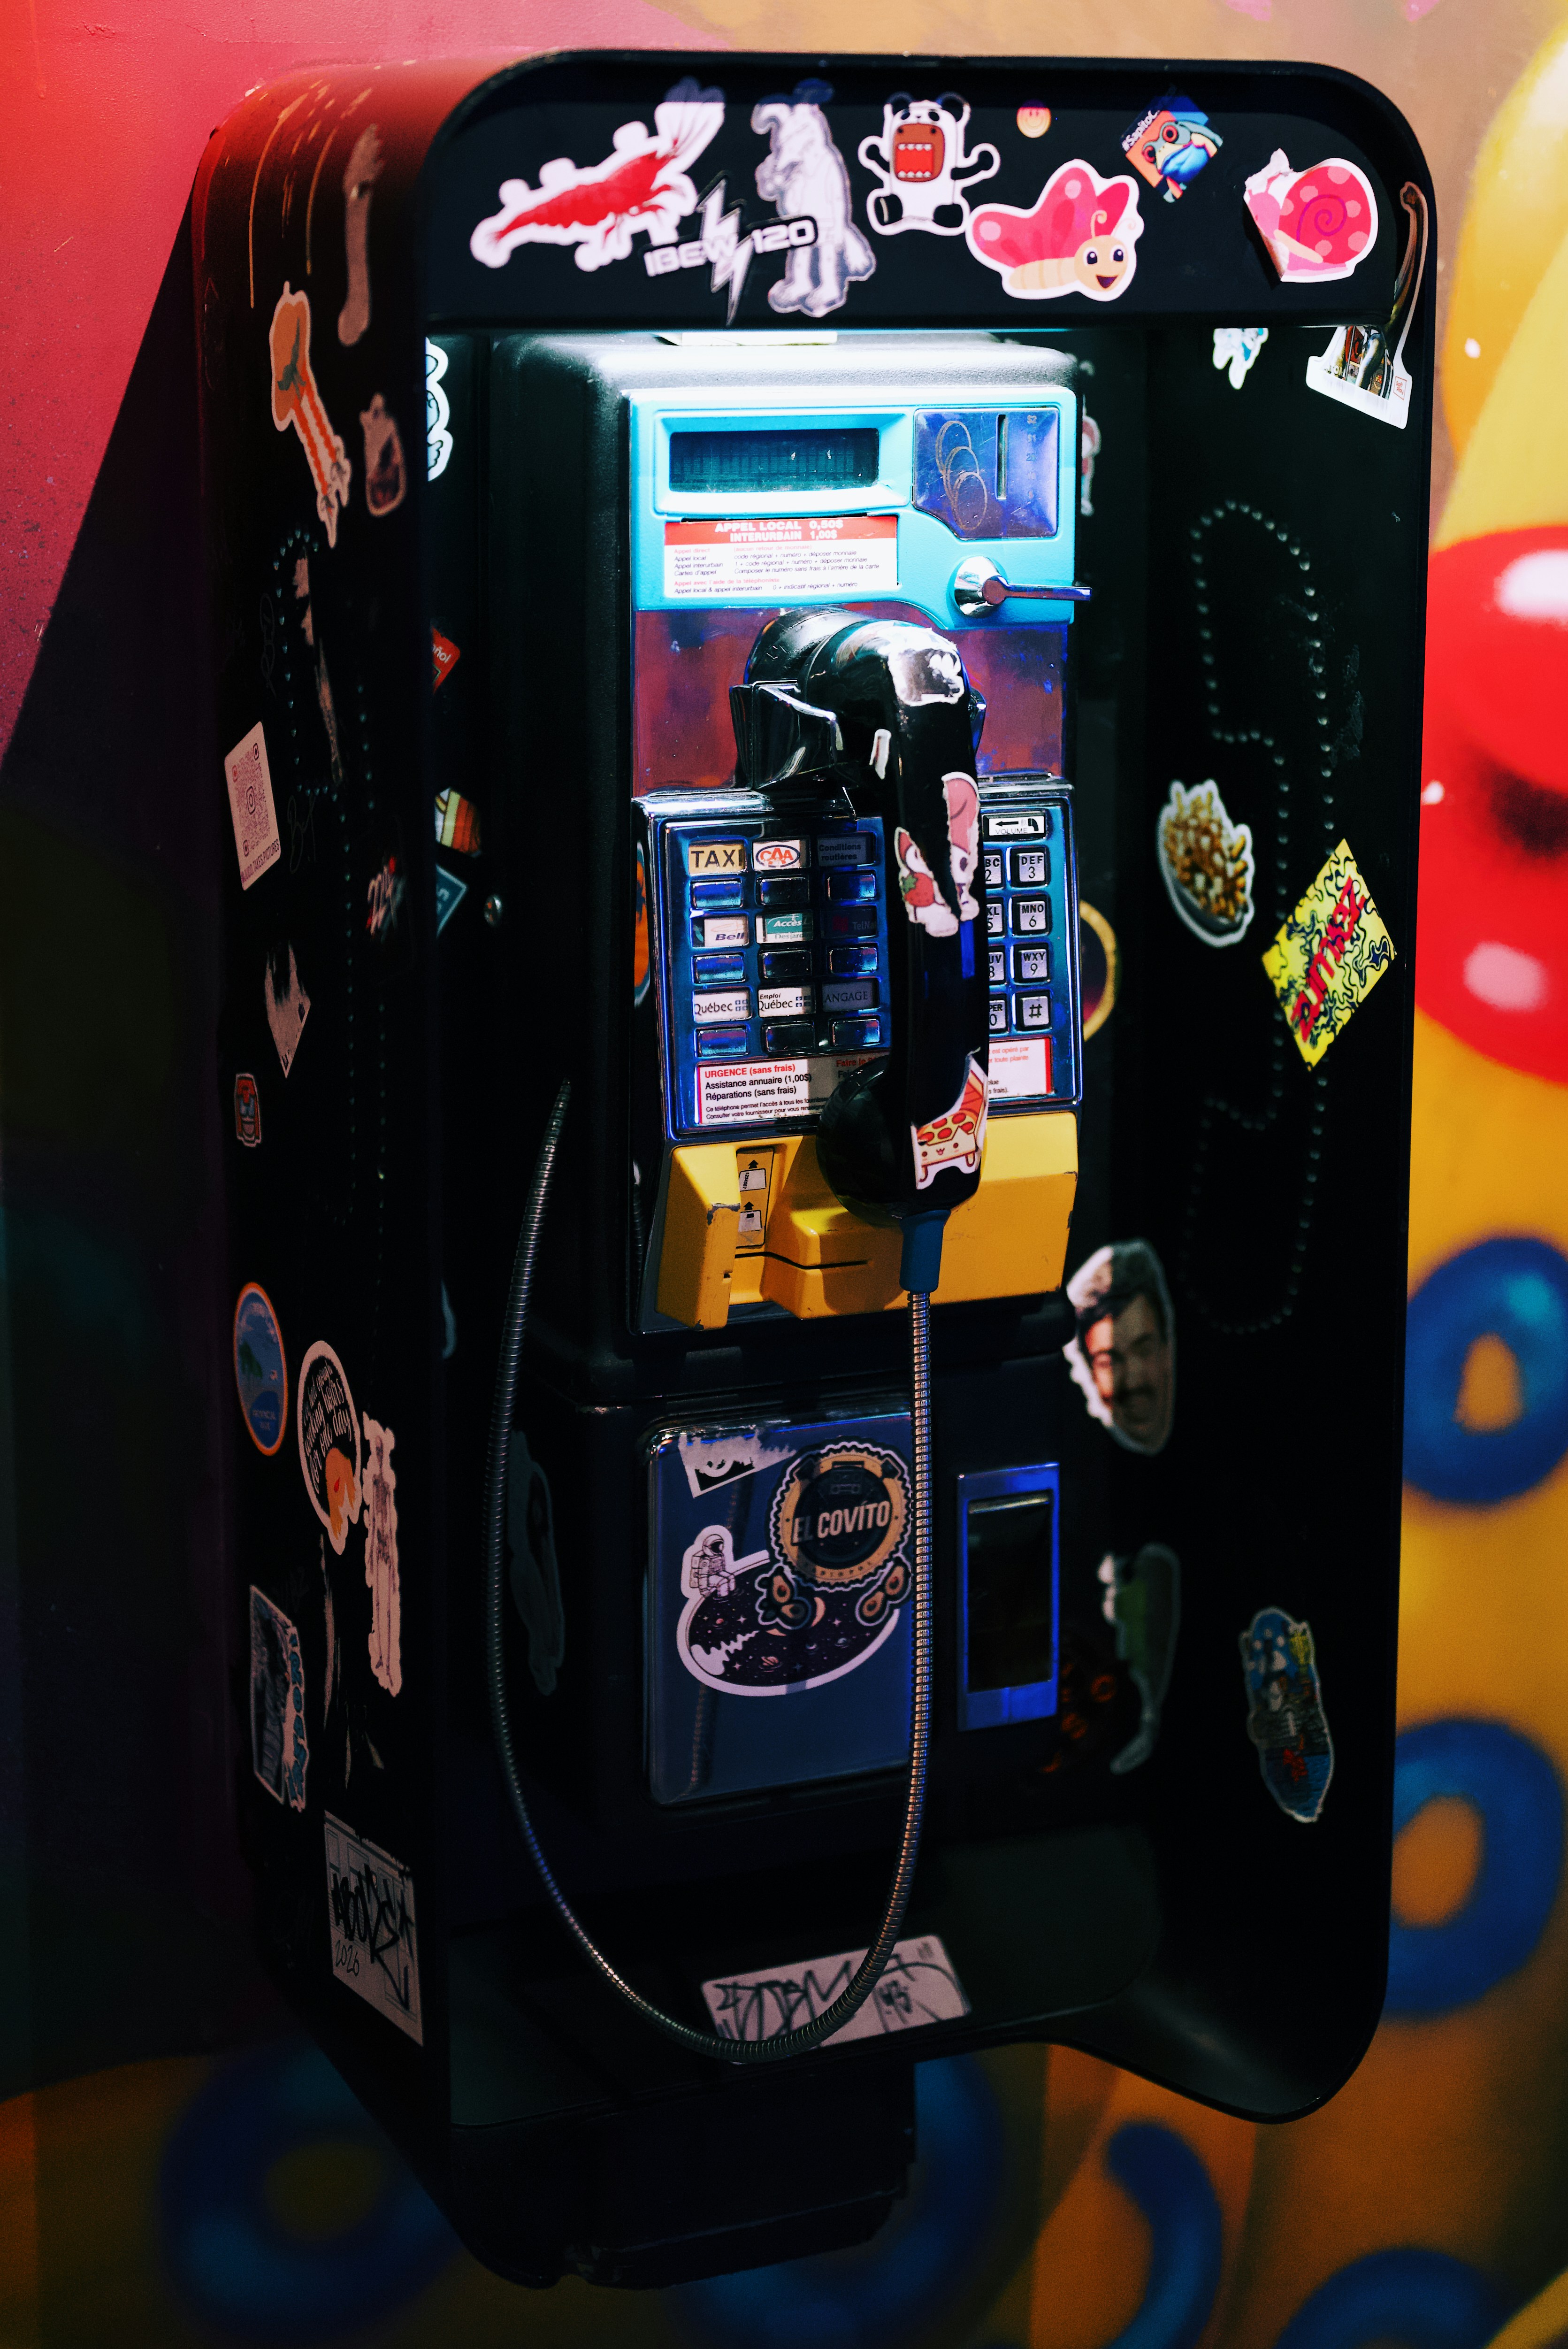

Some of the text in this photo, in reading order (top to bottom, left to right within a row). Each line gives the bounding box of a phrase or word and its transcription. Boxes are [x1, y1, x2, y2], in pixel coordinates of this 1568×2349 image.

[644, 220, 816, 276] IBEW 120
[715, 520, 843, 532] APPEL LOCAL 0,50$
[730, 530, 837, 542] INTERURBAIN 1,00$
[819, 843, 861, 852] Conditions
[691, 848, 745, 868] TAXI
[985, 856, 1043, 867] BC DEF
[986, 867, 1035, 882] 2 3
[1022, 904, 1044, 913] MNO
[987, 916, 1037, 929] 5 6
[715, 932, 745, 941] Bell
[1023, 953, 1045, 961] WXY
[989, 963, 1038, 978] 8 9
[825, 991, 868, 1003] ANGAGE
[694, 1000, 733, 1015] Québec
[758, 999, 793, 1012] Québec
[1029, 1004, 1042, 1018] #
[704, 1067, 747, 1078] URGENCE
[749, 1066, 772, 1076] (sans
[774, 1063, 796, 1073] frais)
[705, 1080, 747, 1090] Assistance
[749, 1077, 782, 1086] annuaire
[785, 1073, 812, 1084] (1,00$)
[706, 1086, 797, 1101] Réparations (sans frais)
[332, 1405, 352, 1442] day
[792, 1516, 813, 1544] EL
[336, 1939, 360, 1977] 2026
